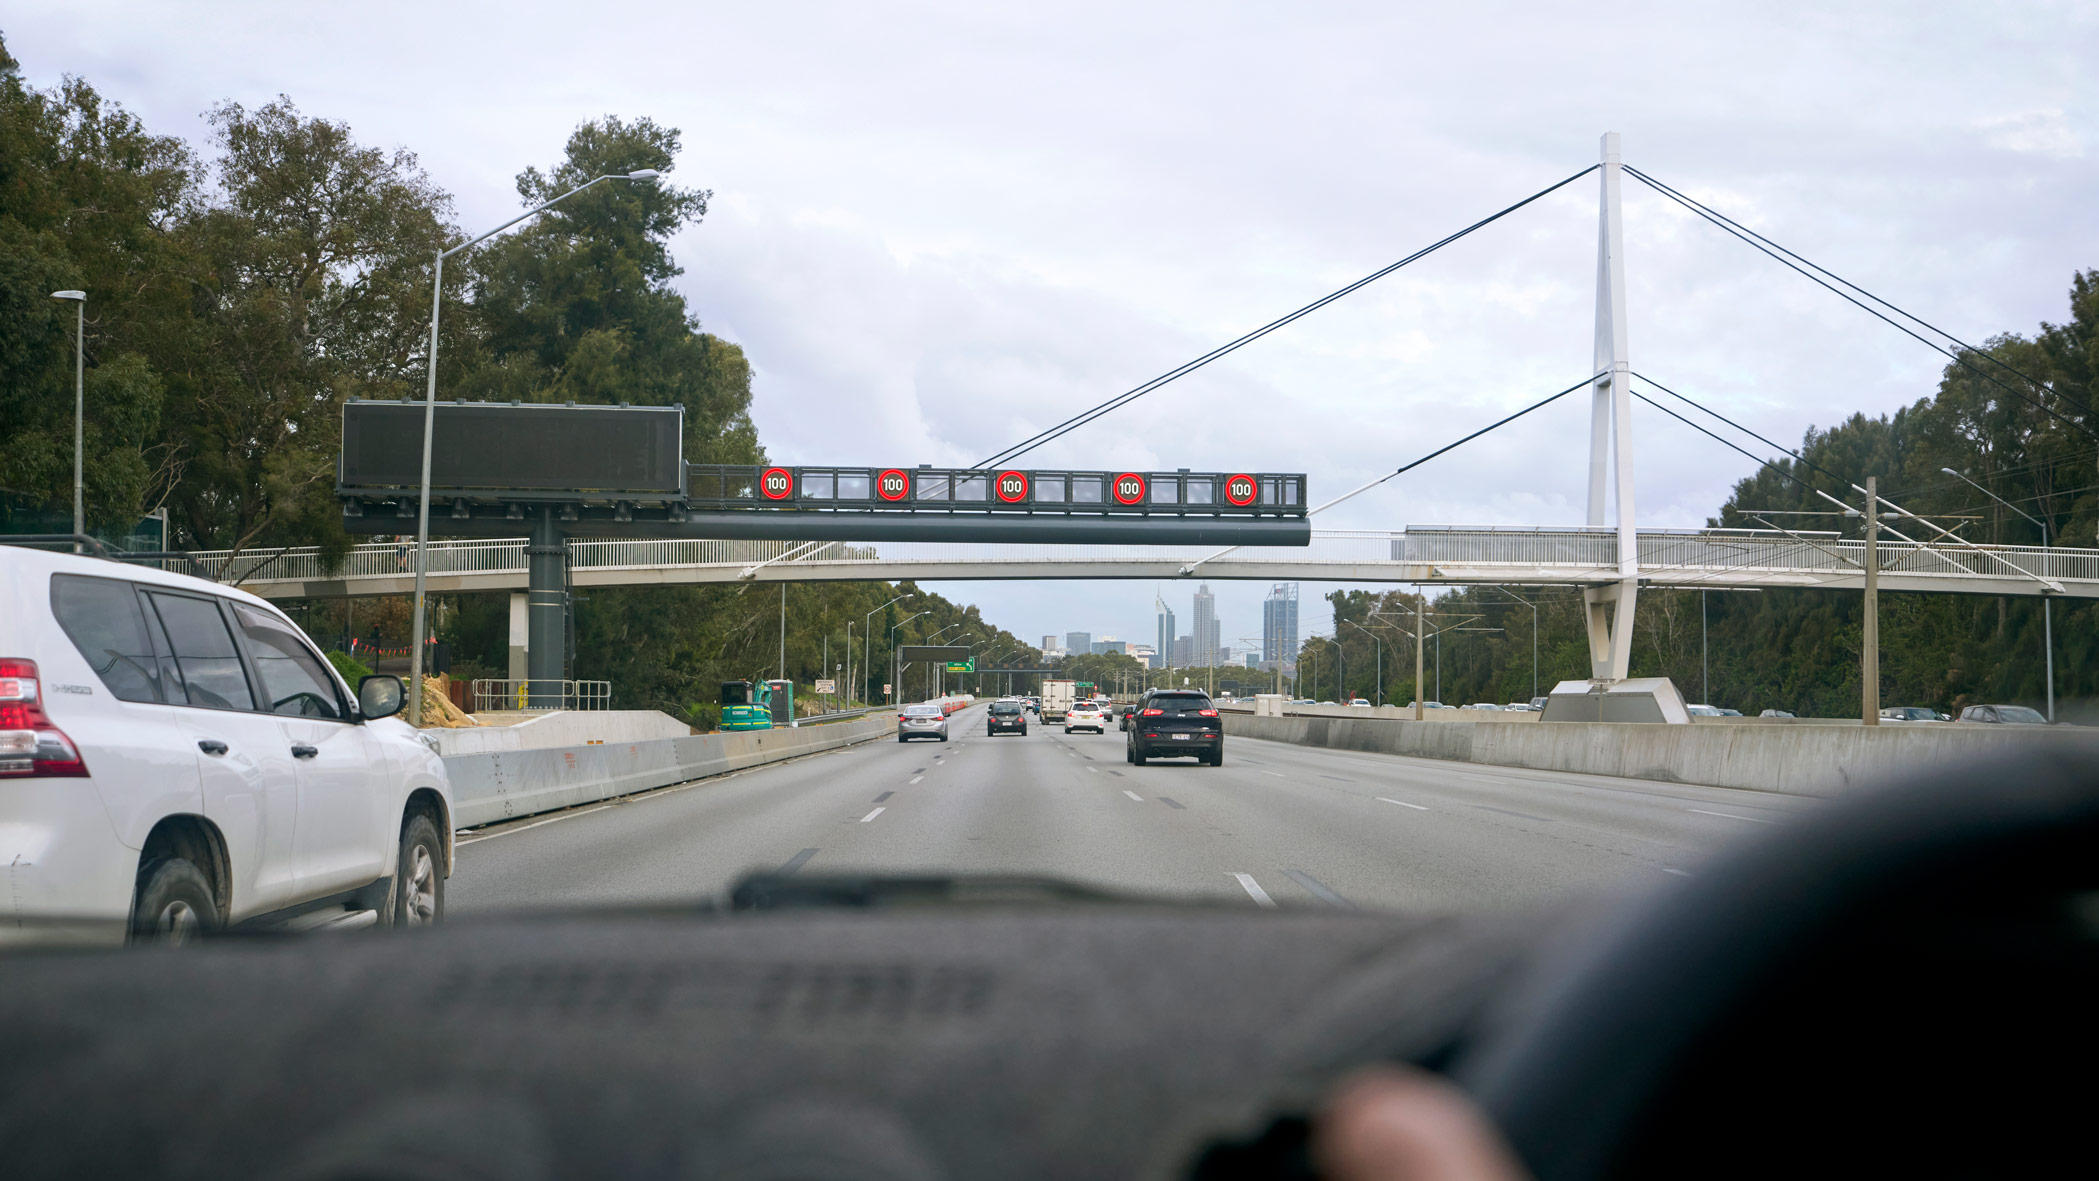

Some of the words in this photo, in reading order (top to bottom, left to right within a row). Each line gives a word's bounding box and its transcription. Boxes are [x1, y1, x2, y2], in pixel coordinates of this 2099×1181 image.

[767, 477, 786, 489] 100
[884, 479, 903, 491] 100
[1003, 481, 1021, 493] 100
[1120, 483, 1139, 495] 100
[1232, 484, 1251, 496] 100
